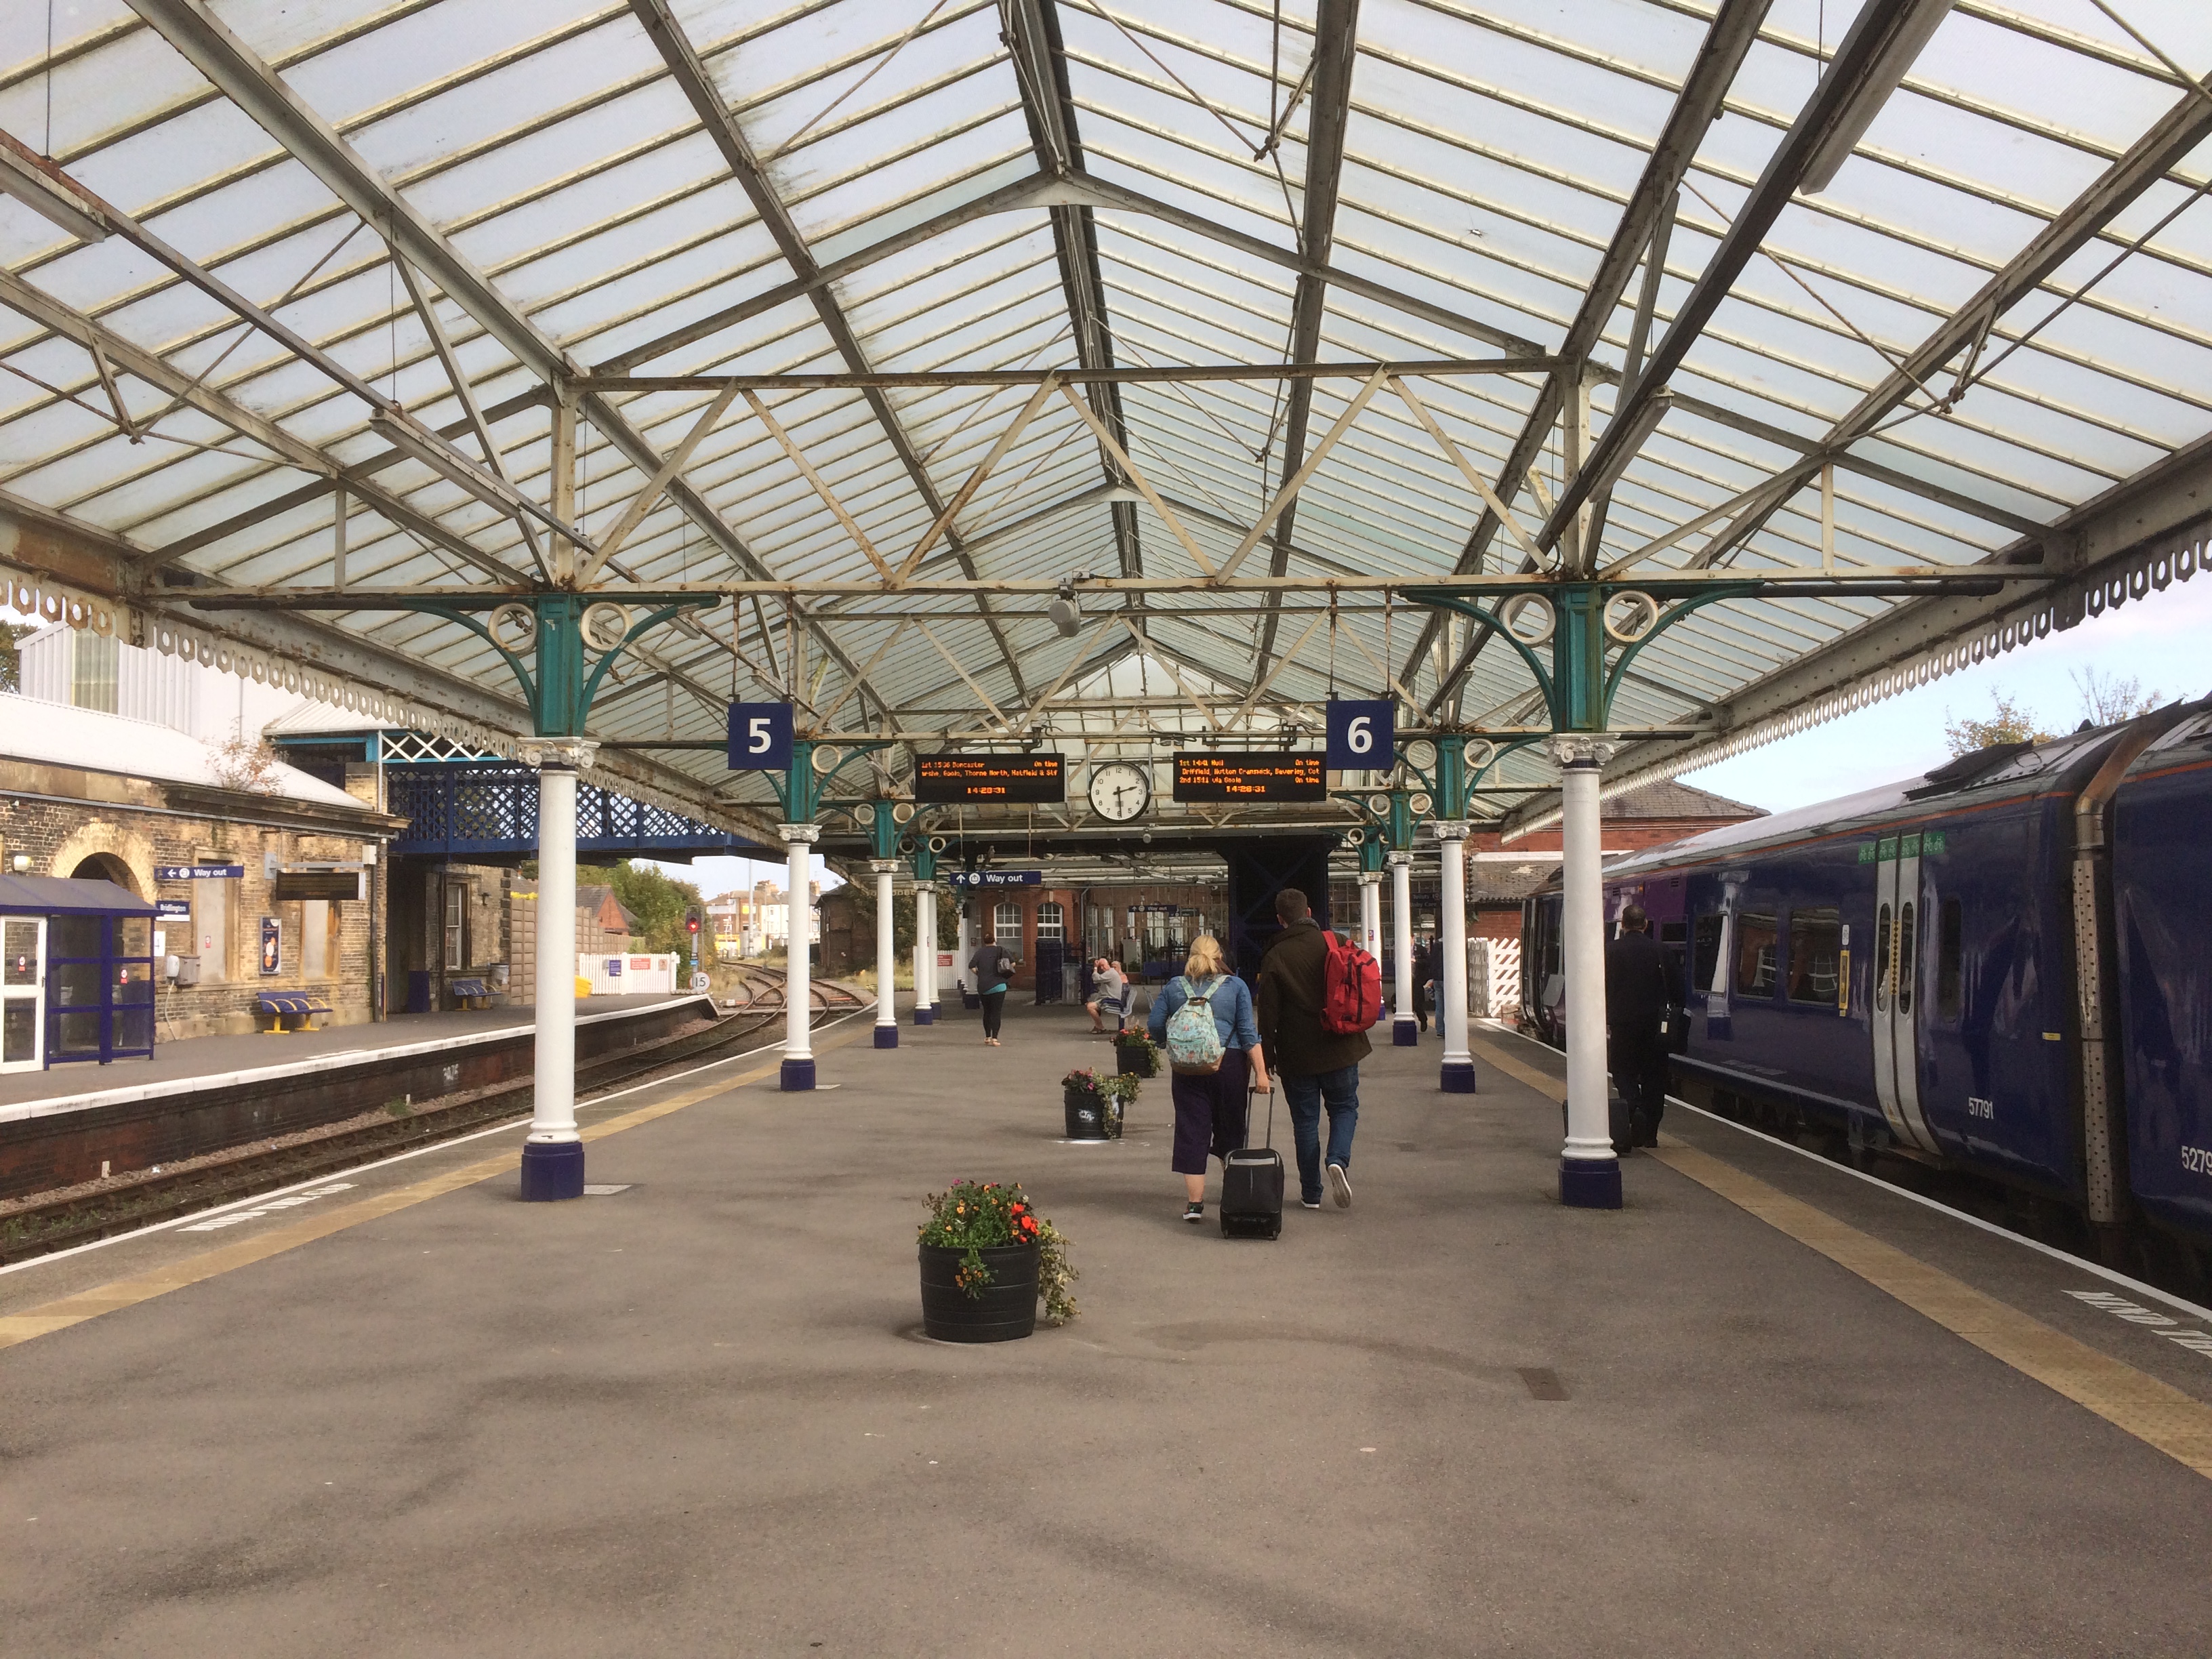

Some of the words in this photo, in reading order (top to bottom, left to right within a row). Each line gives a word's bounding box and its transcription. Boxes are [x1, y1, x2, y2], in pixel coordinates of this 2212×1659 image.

[749, 718, 771, 754] 5
[1347, 716, 1372, 754] 6
[194, 869, 211, 878] Way
[986, 874, 1005, 884] Way
[160, 903, 186, 913] Bridlington
[695, 977, 706, 987] 15
[1969, 1097, 1994, 1120] 57791
[2182, 1145, 2212, 1176] 5279
